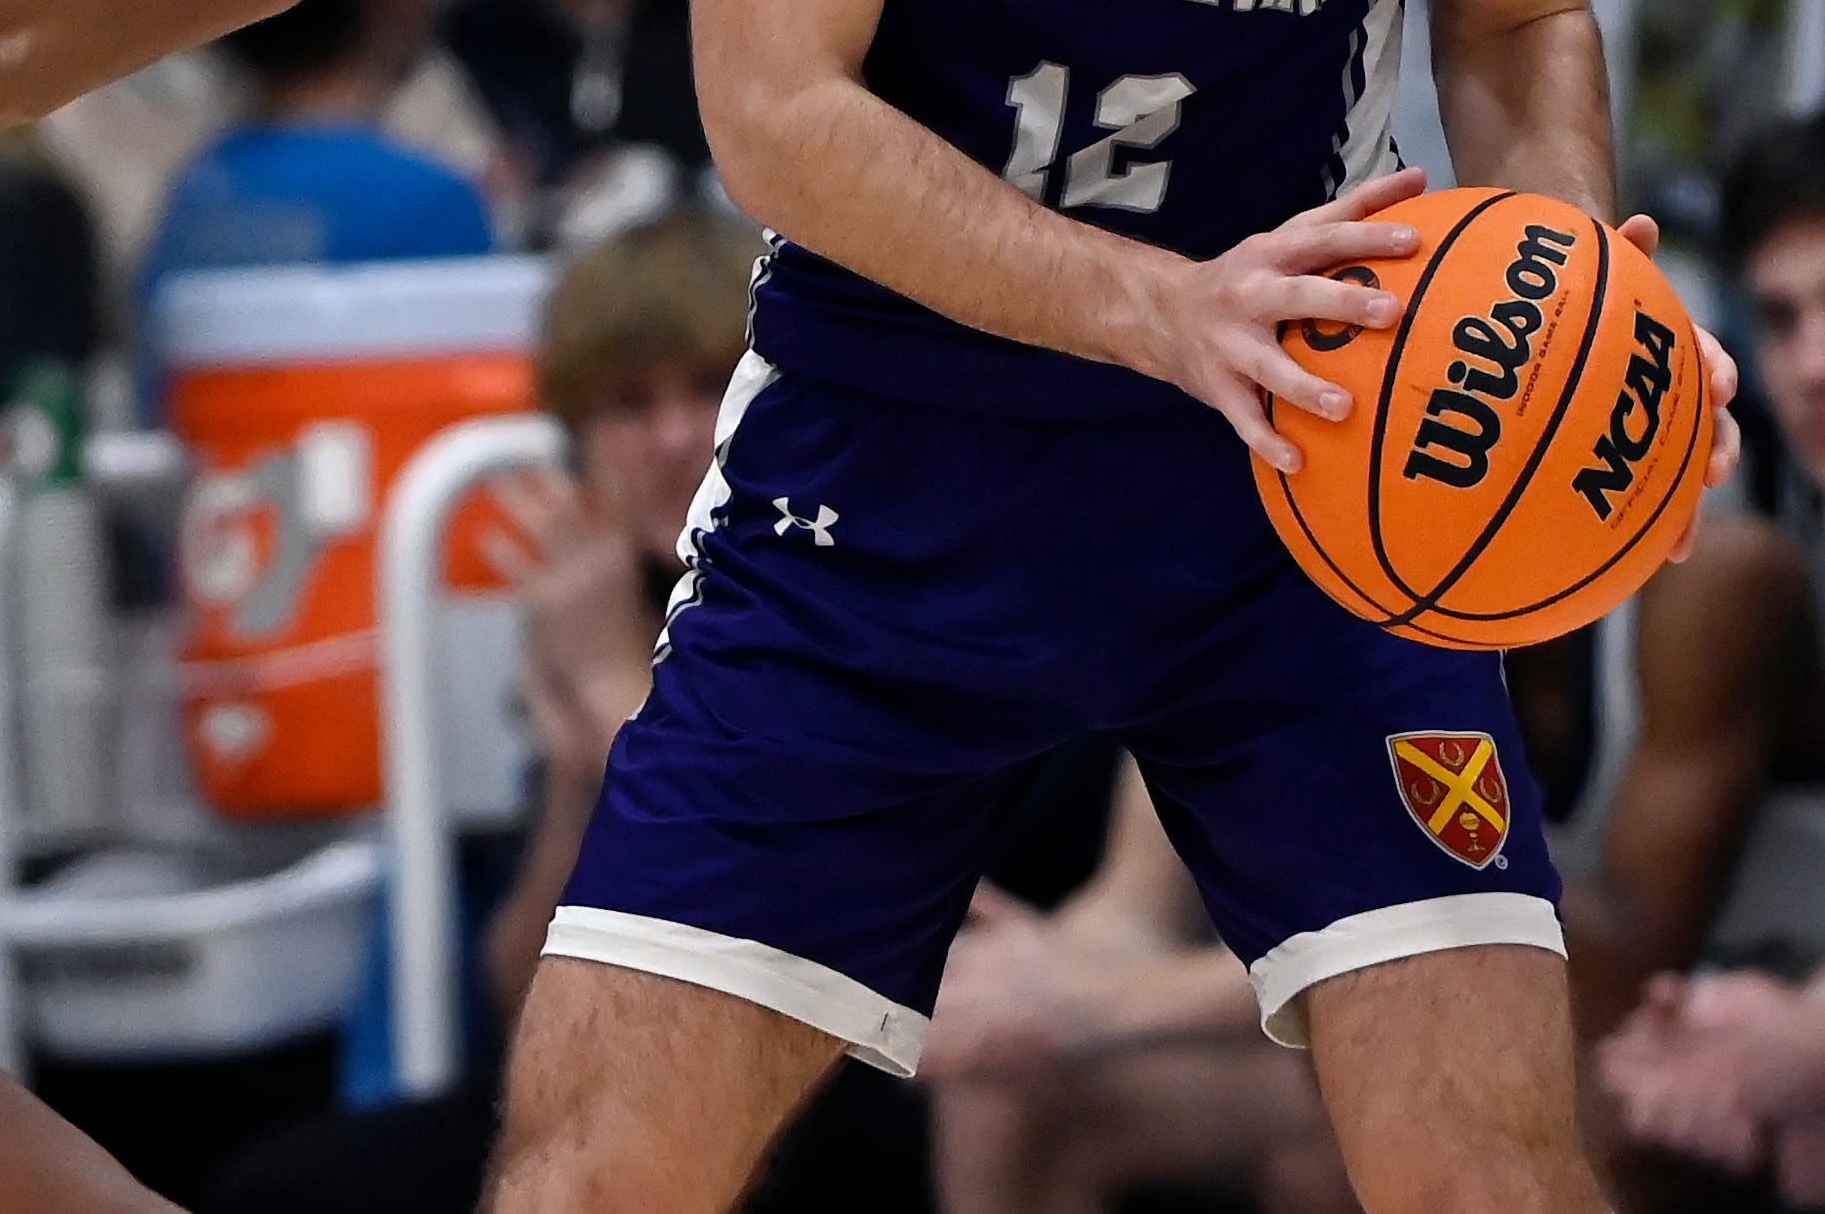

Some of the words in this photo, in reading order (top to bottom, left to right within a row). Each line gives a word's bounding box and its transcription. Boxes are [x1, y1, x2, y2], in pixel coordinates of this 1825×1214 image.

[1002, 60, 1197, 214] 12
[1403, 224, 1576, 488] Wilson
[1517, 362, 1542, 418] INDOOR
[1571, 309, 1676, 522] NCAA
